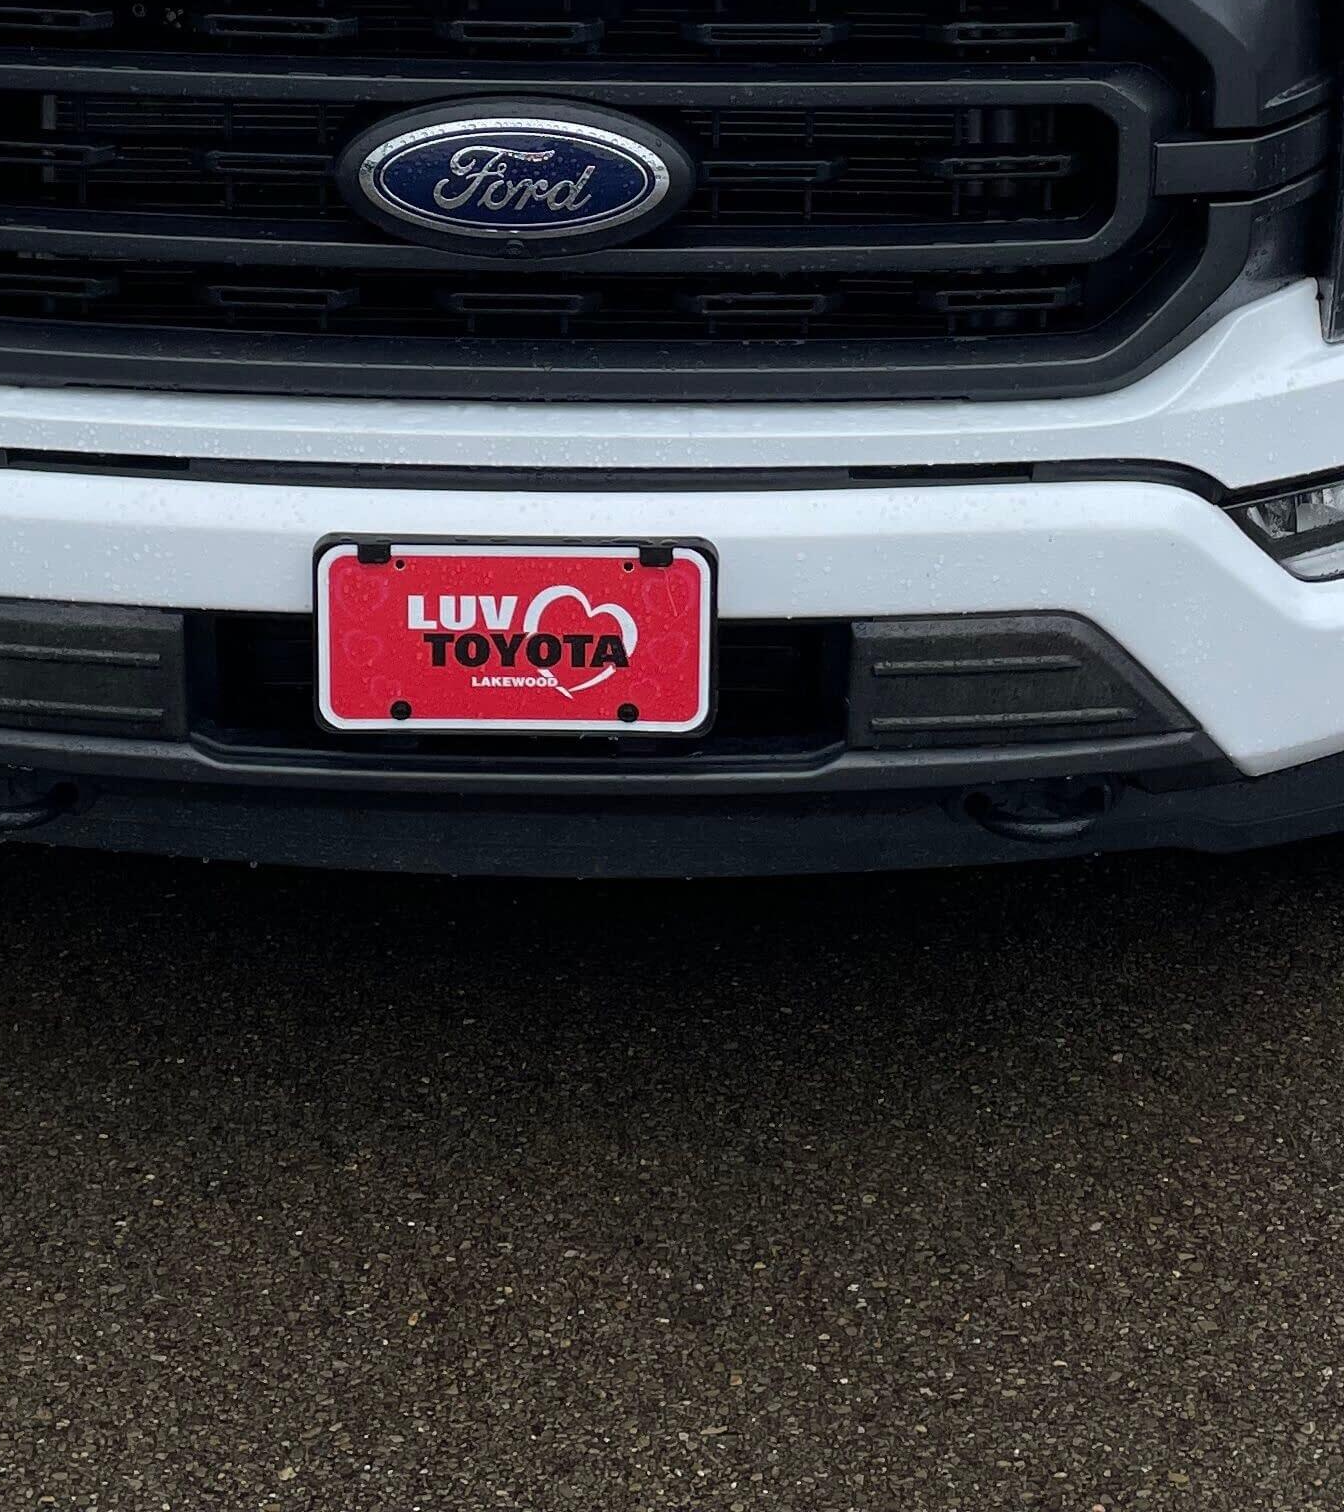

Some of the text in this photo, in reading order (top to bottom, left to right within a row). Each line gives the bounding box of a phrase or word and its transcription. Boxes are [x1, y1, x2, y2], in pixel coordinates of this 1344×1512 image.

[432, 144, 596, 212] Ford
[406, 594, 519, 632] LUV
[423, 632, 631, 669] TOYOTA
[471, 675, 560, 688] LAKEWOOD
